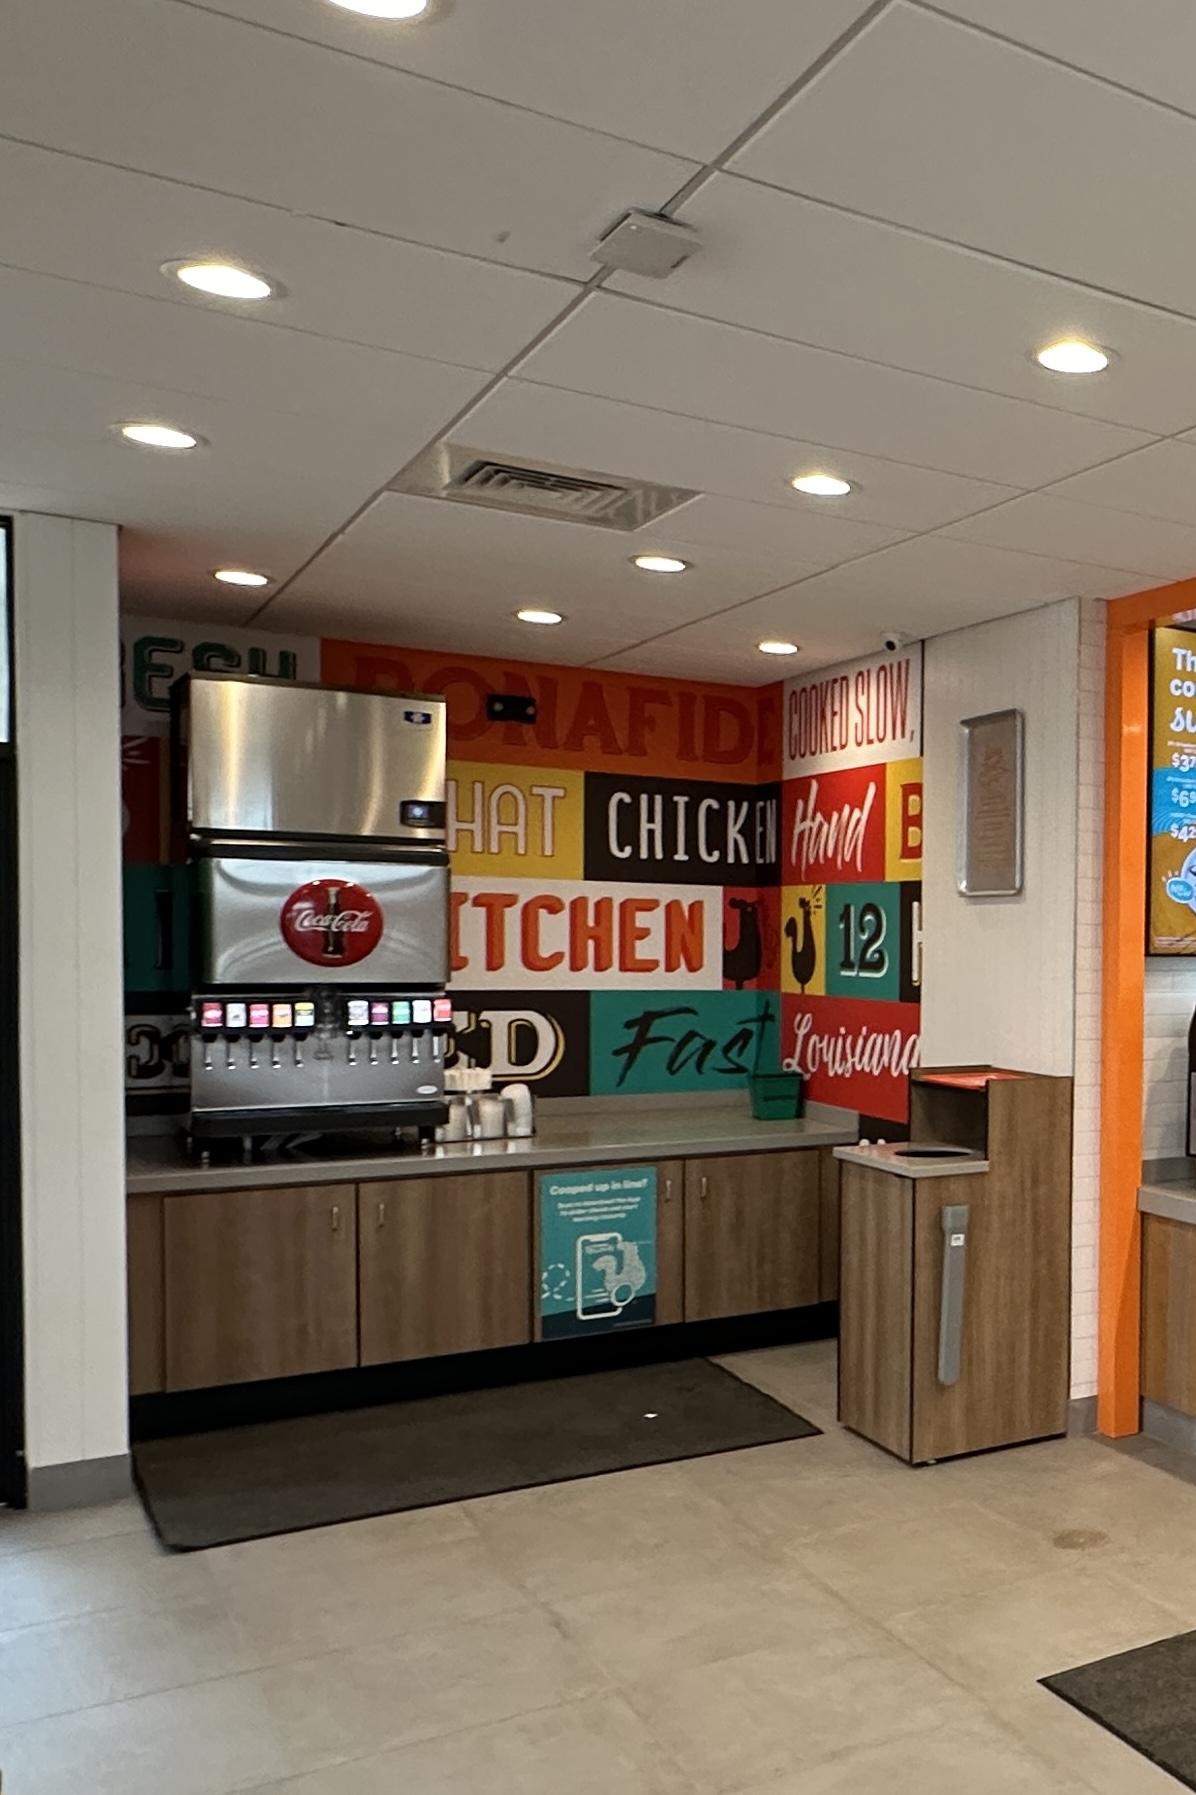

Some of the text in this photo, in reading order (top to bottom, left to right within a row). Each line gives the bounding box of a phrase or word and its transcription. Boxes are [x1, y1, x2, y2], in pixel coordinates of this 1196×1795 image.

[788, 658, 915, 760] COOKED SLOW,
[447, 779, 777, 865] HAT CHICKEN
[791, 778, 877, 882] Hand
[450, 892, 705, 973] ITCHEN
[839, 902, 888, 978] 12
[612, 999, 776, 1088] Fast
[782, 1012, 921, 1081] Louisiana
